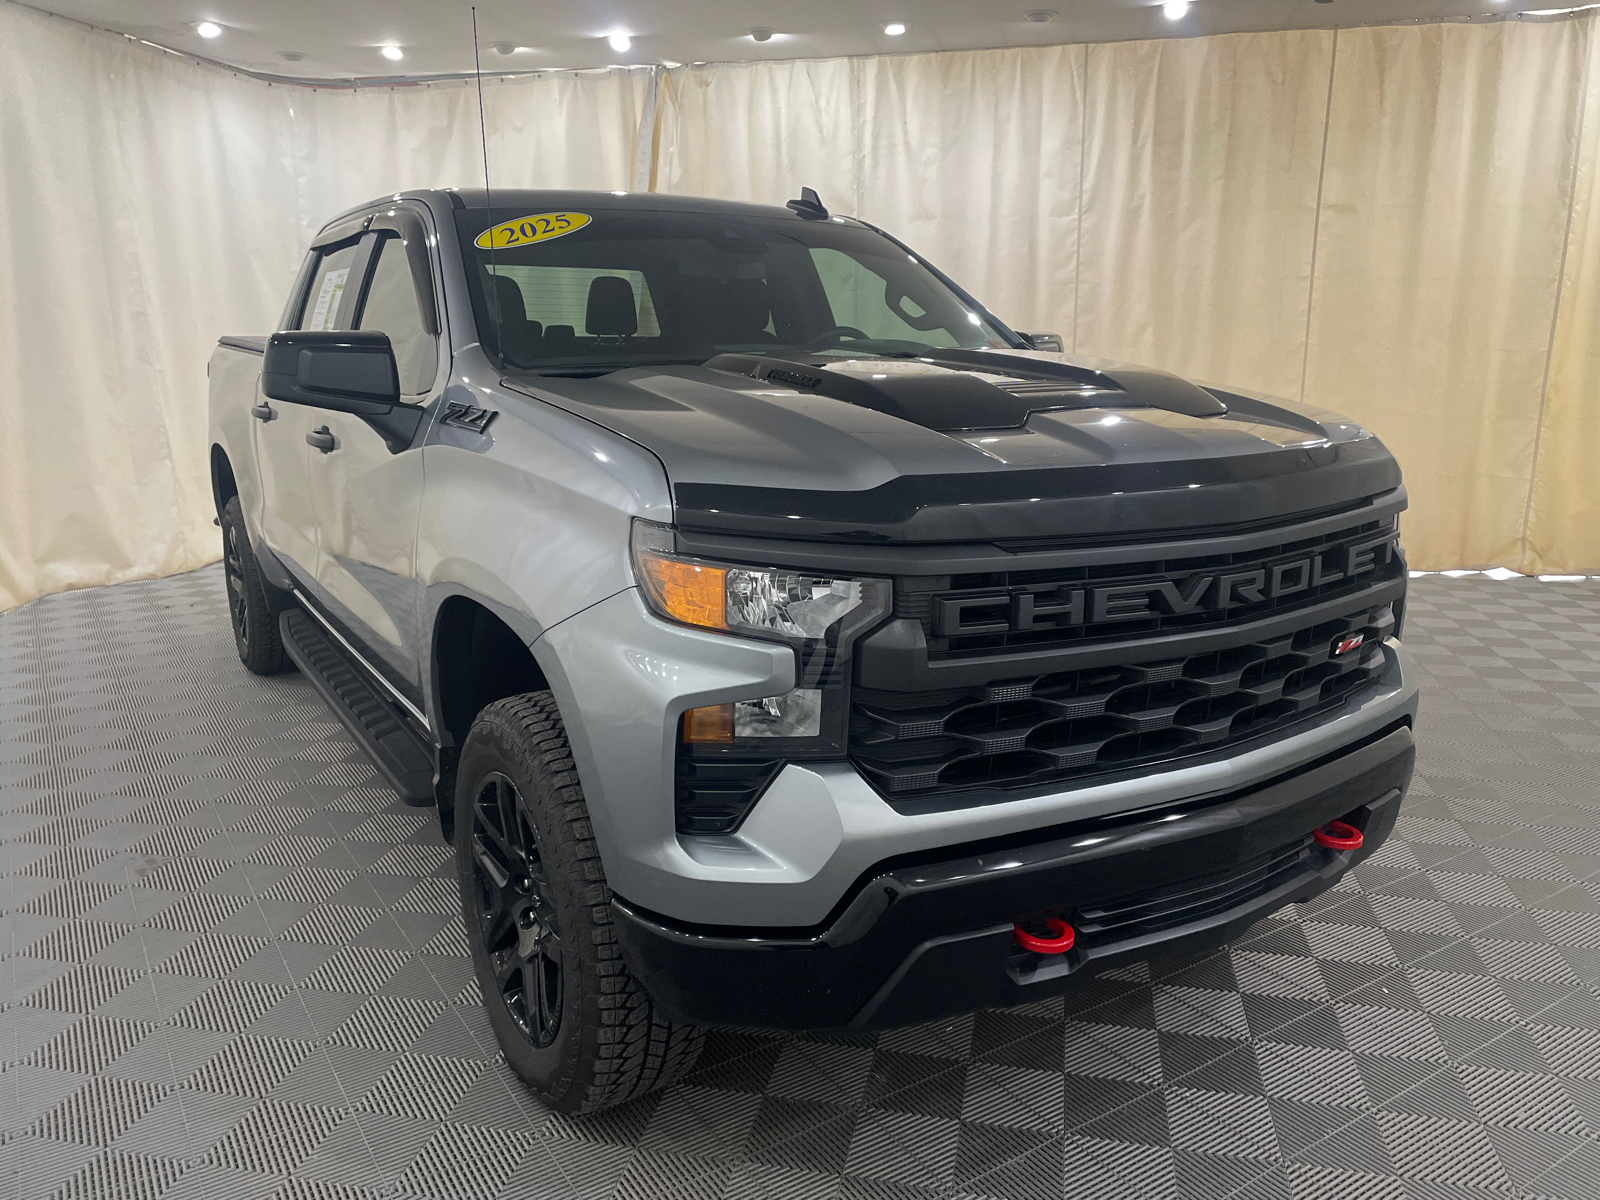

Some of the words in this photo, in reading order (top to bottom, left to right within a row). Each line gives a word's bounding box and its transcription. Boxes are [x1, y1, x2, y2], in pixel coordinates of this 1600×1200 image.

[500, 214, 571, 245] 2025
[440, 401, 499, 434] Z71
[935, 531, 1401, 637] CHEVROLET
